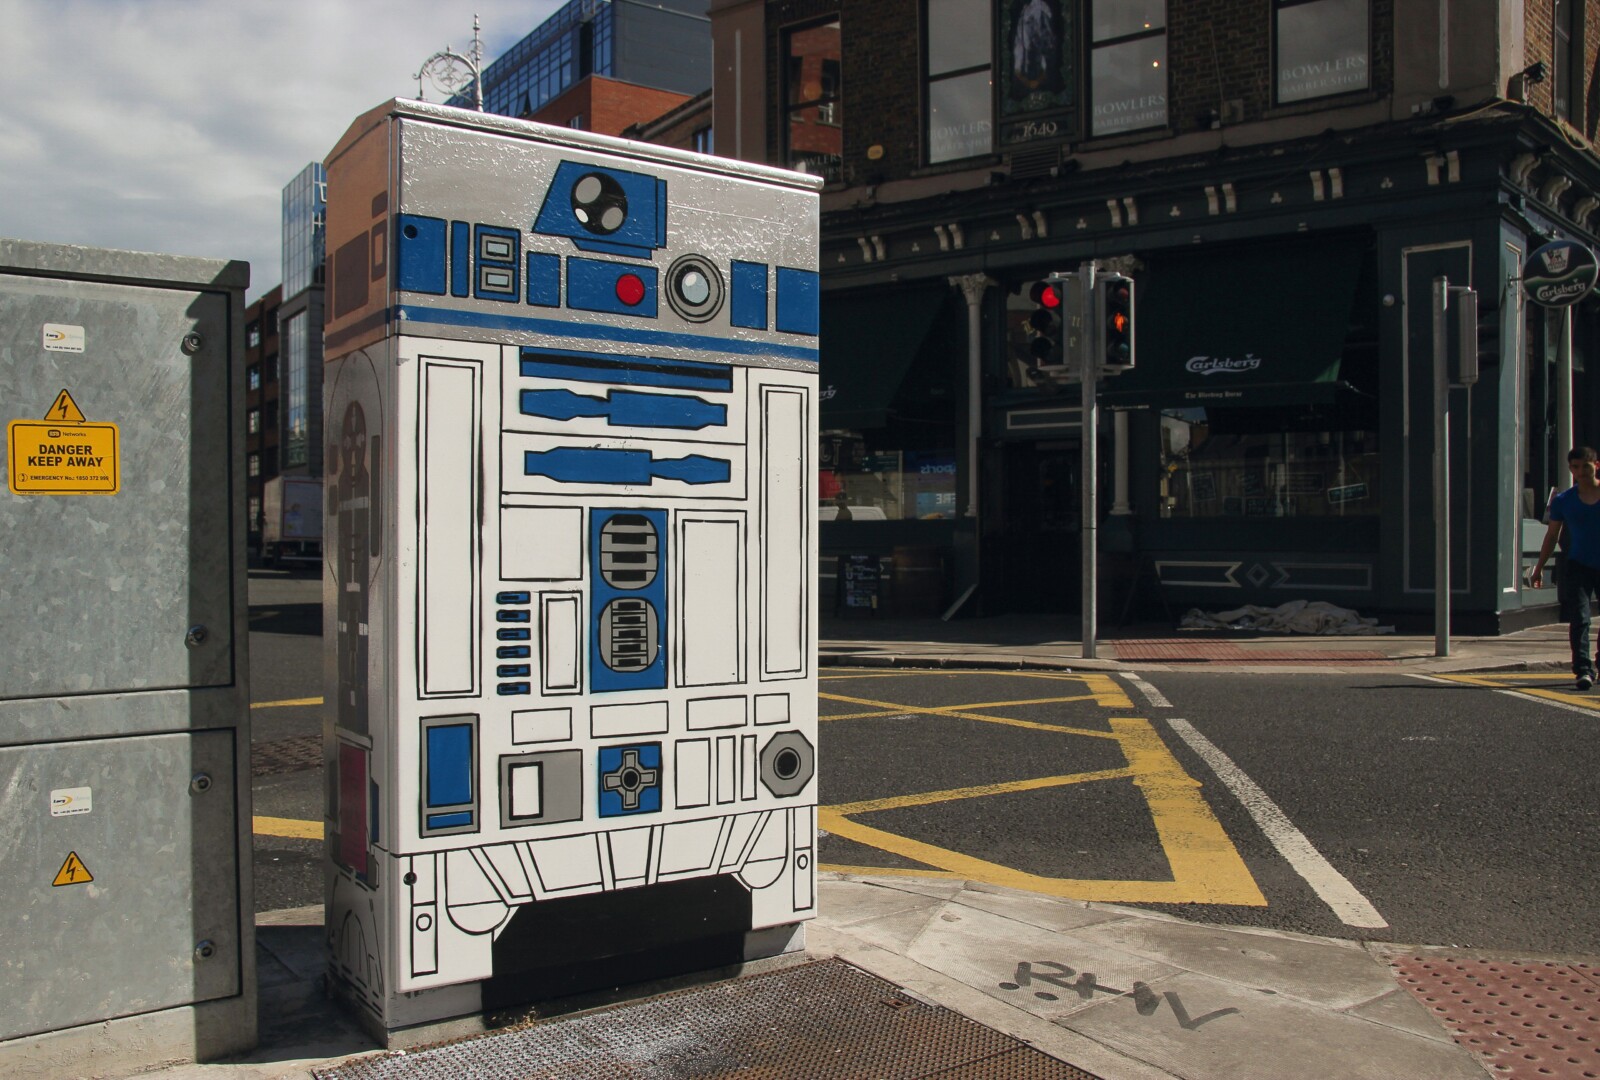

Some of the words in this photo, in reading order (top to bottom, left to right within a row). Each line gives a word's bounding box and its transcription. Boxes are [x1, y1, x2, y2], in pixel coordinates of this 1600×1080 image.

[1282, 55, 1366, 80] BOWLERS
[1093, 95, 1166, 117] BOWLERS
[1537, 278, 1586, 302] Carlsberg
[1185, 353, 1261, 375] Carlsberg
[38, 444, 93, 455] DANGER
[27, 455, 63, 467] KEEP
[66, 456, 104, 468] AWAY
